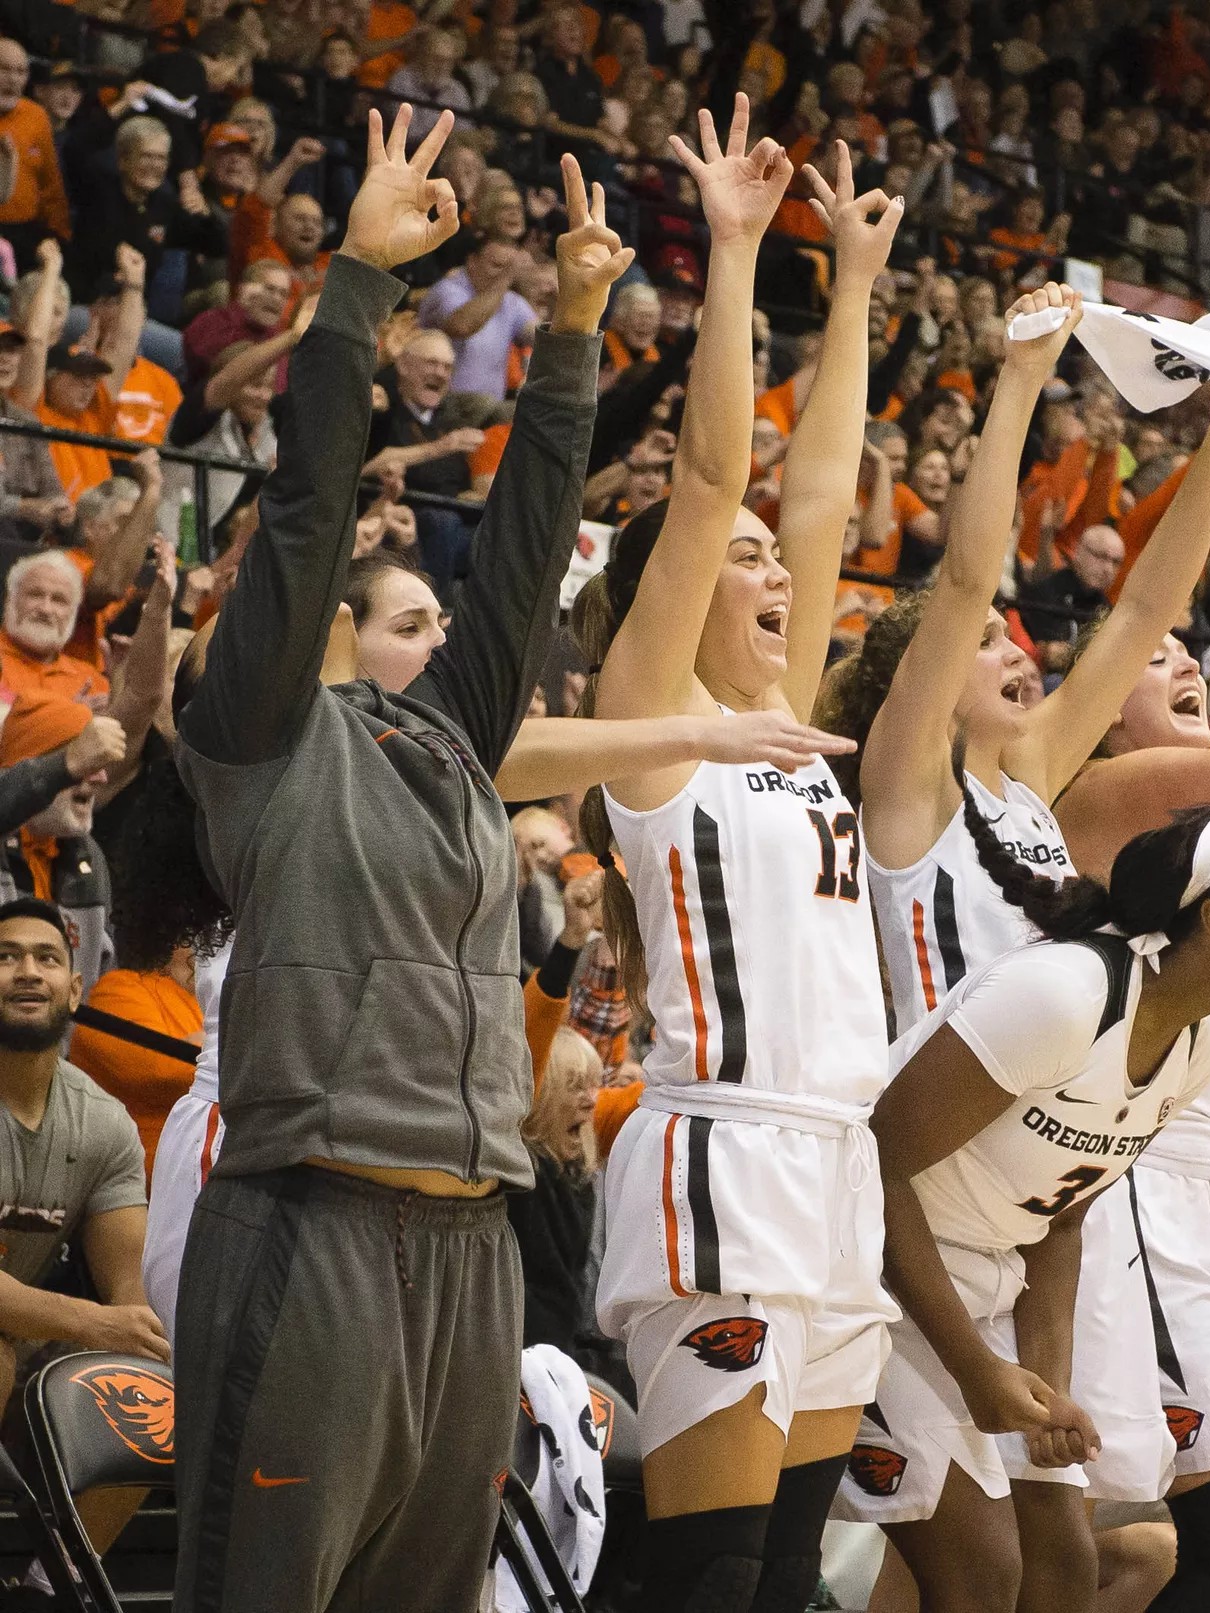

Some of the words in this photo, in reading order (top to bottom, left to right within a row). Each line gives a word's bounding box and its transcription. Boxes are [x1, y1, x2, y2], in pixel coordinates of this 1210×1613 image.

[805, 808, 861, 904] 13
[1022, 1106, 1116, 1156] OREGON
[1013, 1164, 1109, 1217] 3
